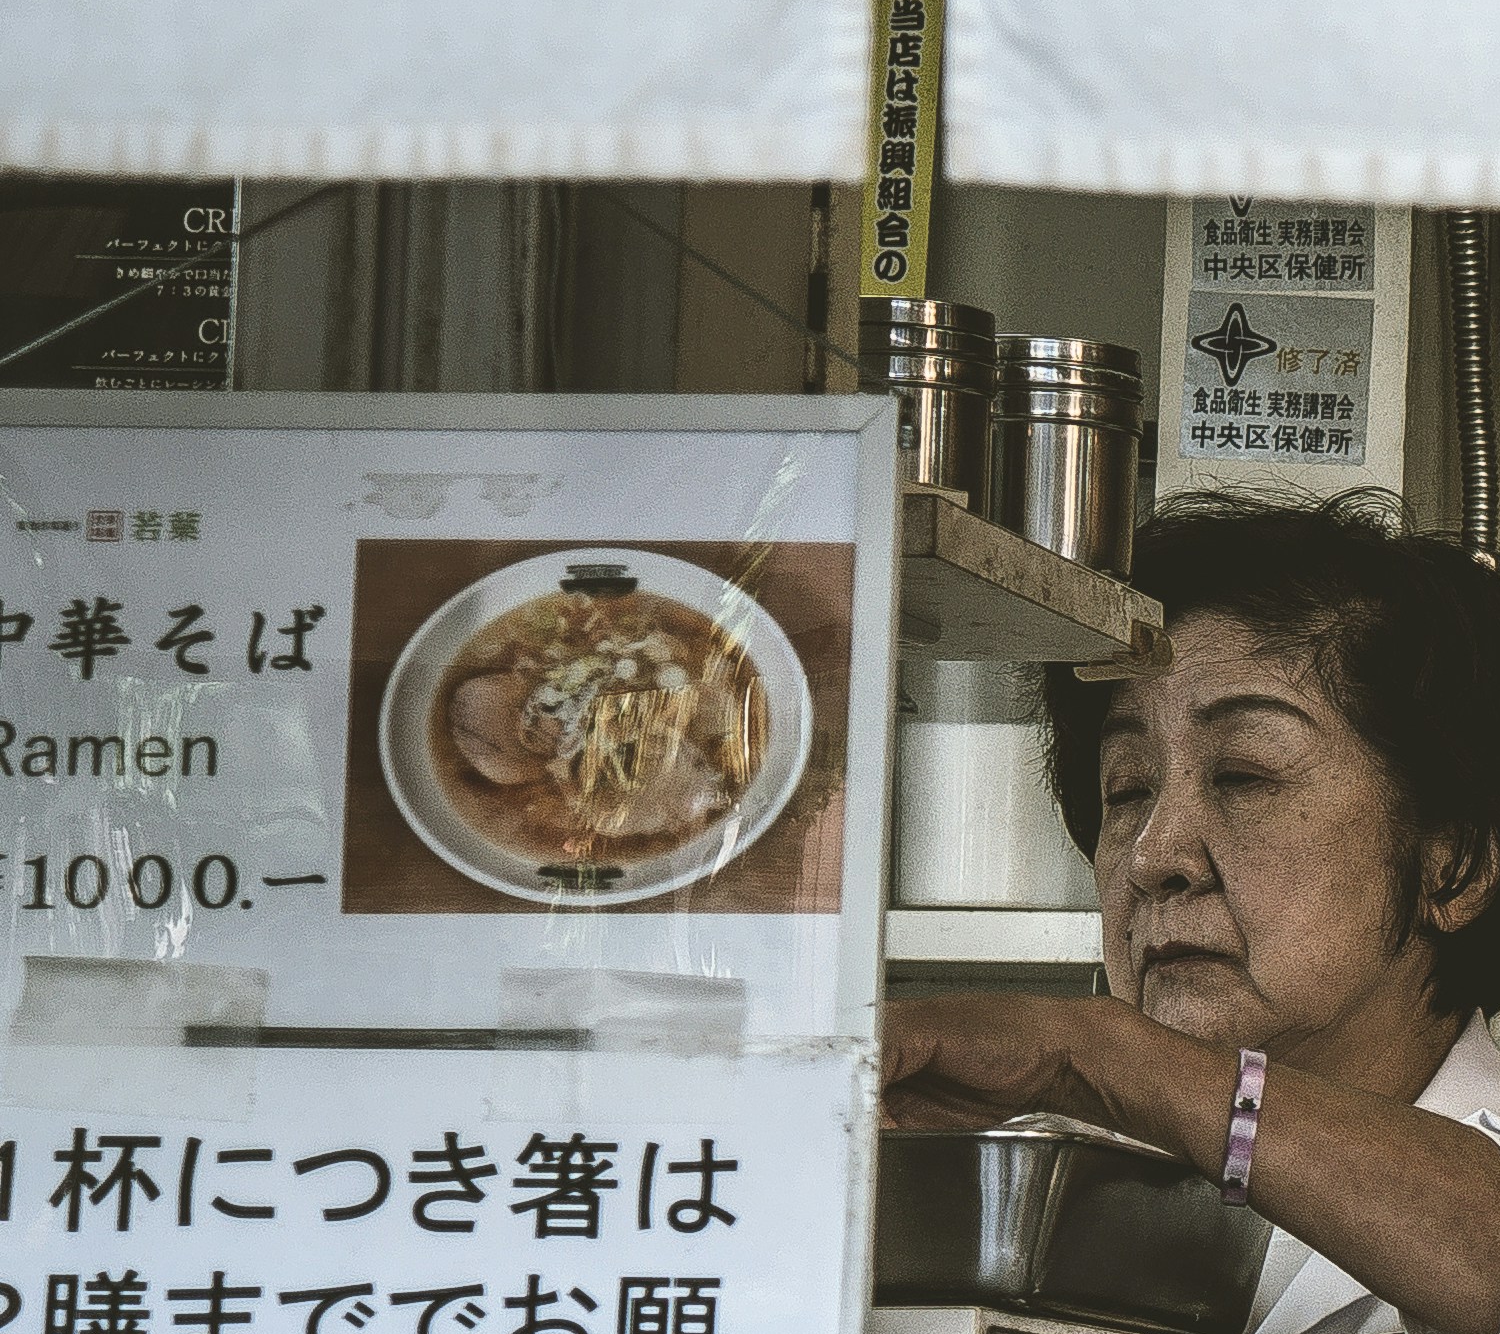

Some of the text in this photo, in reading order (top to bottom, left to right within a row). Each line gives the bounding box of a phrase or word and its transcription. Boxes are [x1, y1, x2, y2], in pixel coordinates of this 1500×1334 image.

[1202, 219, 1366, 247] 食品衛生 実務講習会
[1202, 253, 1366, 281] 中央区保健所
[1275, 347, 1362, 377] 修了済
[1191, 387, 1355, 420] 食品衛生 実務講習会
[1190, 423, 1353, 455] 中央区保健所
